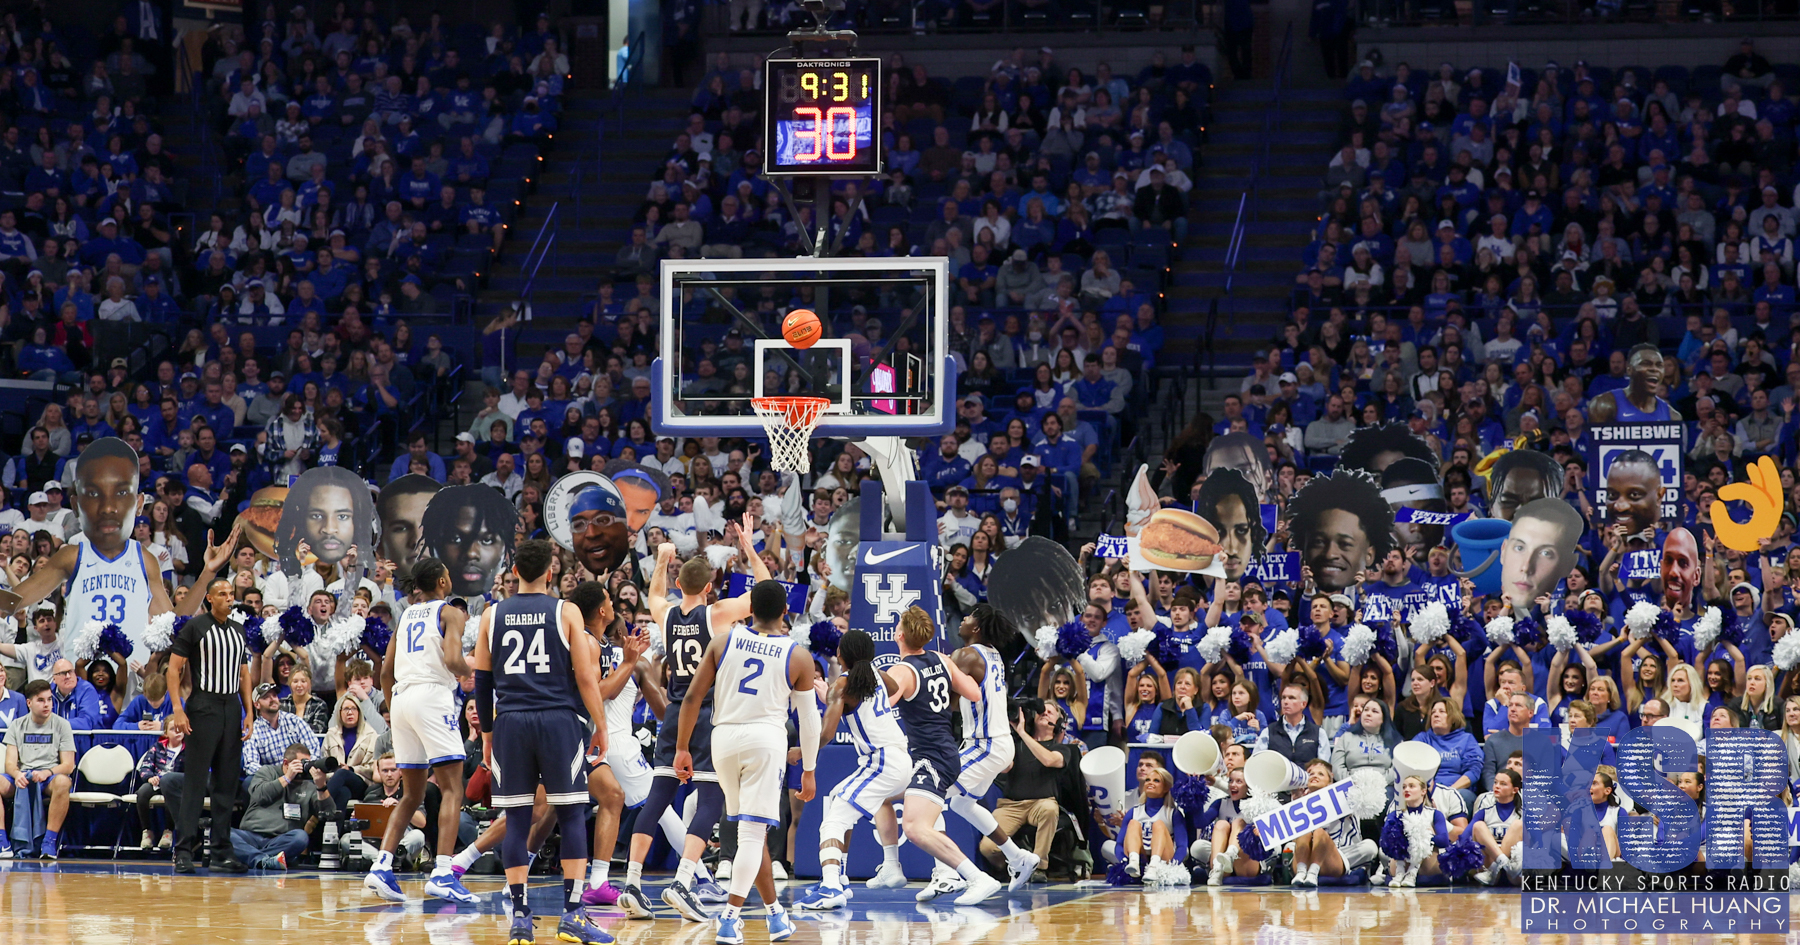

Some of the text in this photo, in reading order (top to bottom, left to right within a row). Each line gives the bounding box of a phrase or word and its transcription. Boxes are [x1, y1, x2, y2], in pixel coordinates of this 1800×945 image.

[801, 72, 868, 102] 9:31
[794, 107, 857, 160] 30
[1590, 425, 1681, 440] TSHIEBWE
[547, 483, 565, 531] LIBERTY
[1411, 510, 1458, 519] KENTUCKY
[1409, 514, 1451, 526] Y'ALL
[1094, 542, 1128, 558] Y'AL
[1098, 534, 1128, 545] ENTUC
[82, 573, 137, 594] KENTUCKY
[1628, 567, 1661, 579] TUCKY
[91, 594, 126, 624] 33
[862, 573, 921, 624] UK
[407, 607, 431, 619] REEVES
[505, 613, 546, 626] GHARRAM
[406, 621, 426, 653] 12
[736, 637, 783, 659] WHEELER
[502, 628, 550, 675] 24
[672, 638, 703, 677] 13
[1243, 661, 1267, 670] NTUCKY
[738, 658, 765, 696] 2
[927, 676, 950, 713] 33
[917, 775, 928, 785] Y
[1255, 780, 1354, 847] MISS IT
